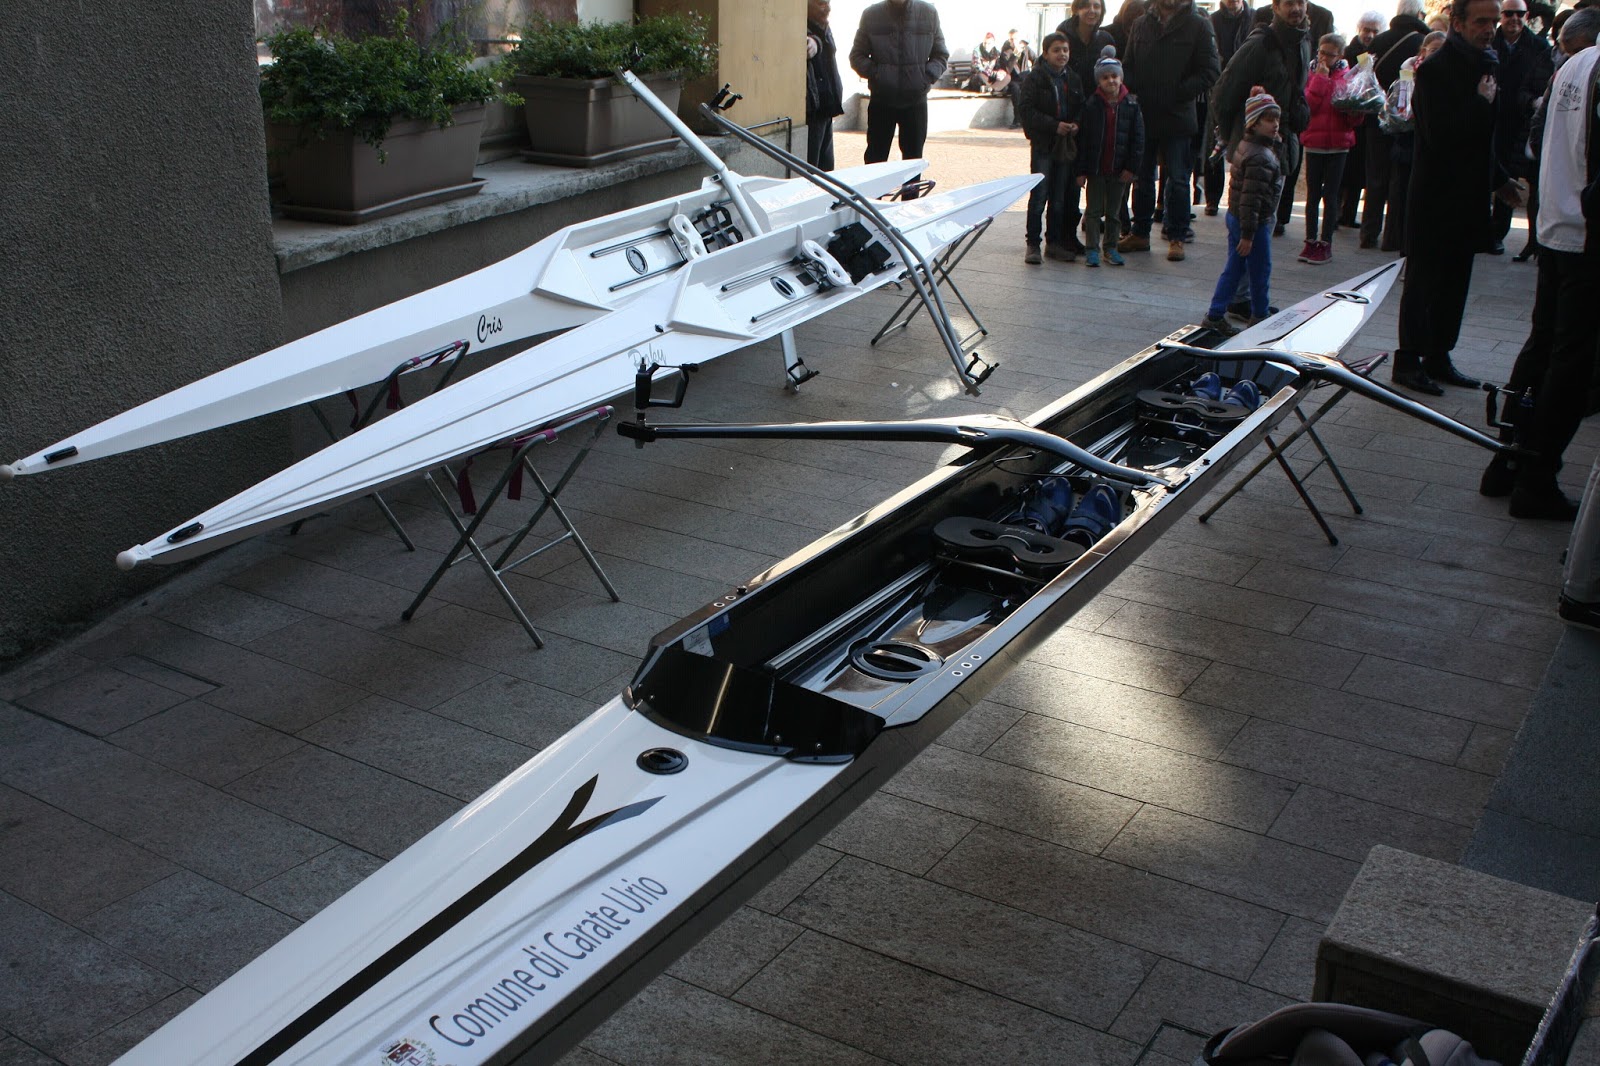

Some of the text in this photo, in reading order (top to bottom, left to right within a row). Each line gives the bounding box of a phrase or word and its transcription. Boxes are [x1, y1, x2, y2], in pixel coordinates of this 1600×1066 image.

[477, 314, 503, 343] Cris
[429, 876, 668, 1047] Comune di Carate Urio
